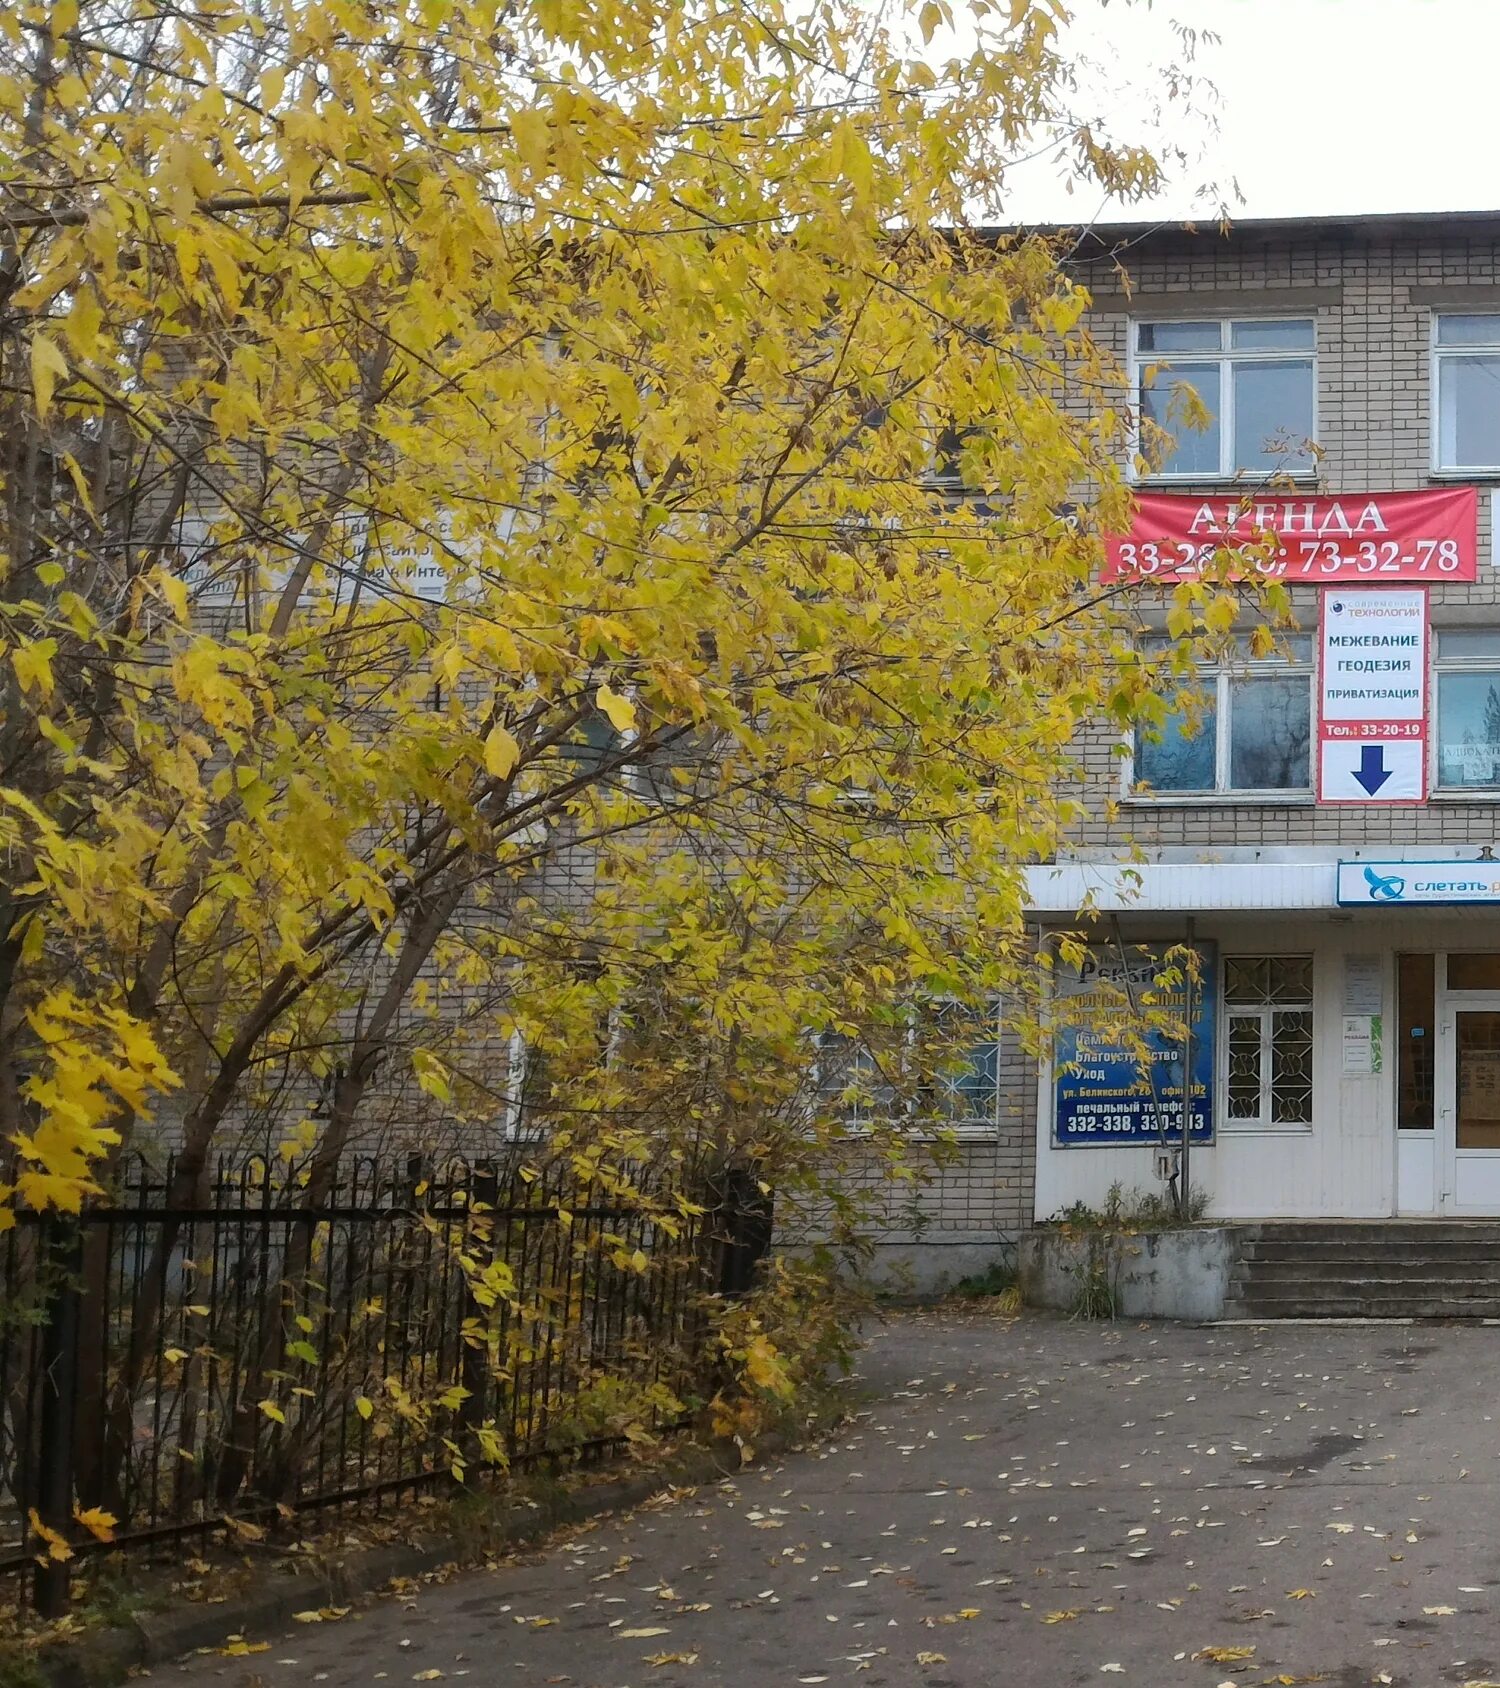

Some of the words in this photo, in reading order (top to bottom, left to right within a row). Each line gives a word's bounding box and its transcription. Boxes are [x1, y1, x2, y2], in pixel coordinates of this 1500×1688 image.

[1187, 501, 1389, 539] АРЕНДА
[1300, 539, 1459, 573] 73-32-78
[1329, 635, 1419, 647] МЕЖЕВАНИЕ
[1338, 660, 1411, 673] ГЕОДЕЗИЯ
[1327, 689, 1419, 700] ПРИВАТИЗАЦИЯ
[1326, 725, 1358, 736] Тел.:
[1361, 724, 1420, 736] 33-20-19
[1063, 1089, 1077, 1100] ул.
[1076, 1101, 1140, 1114] печальный
[1067, 1115, 1137, 1134] 332-338,
